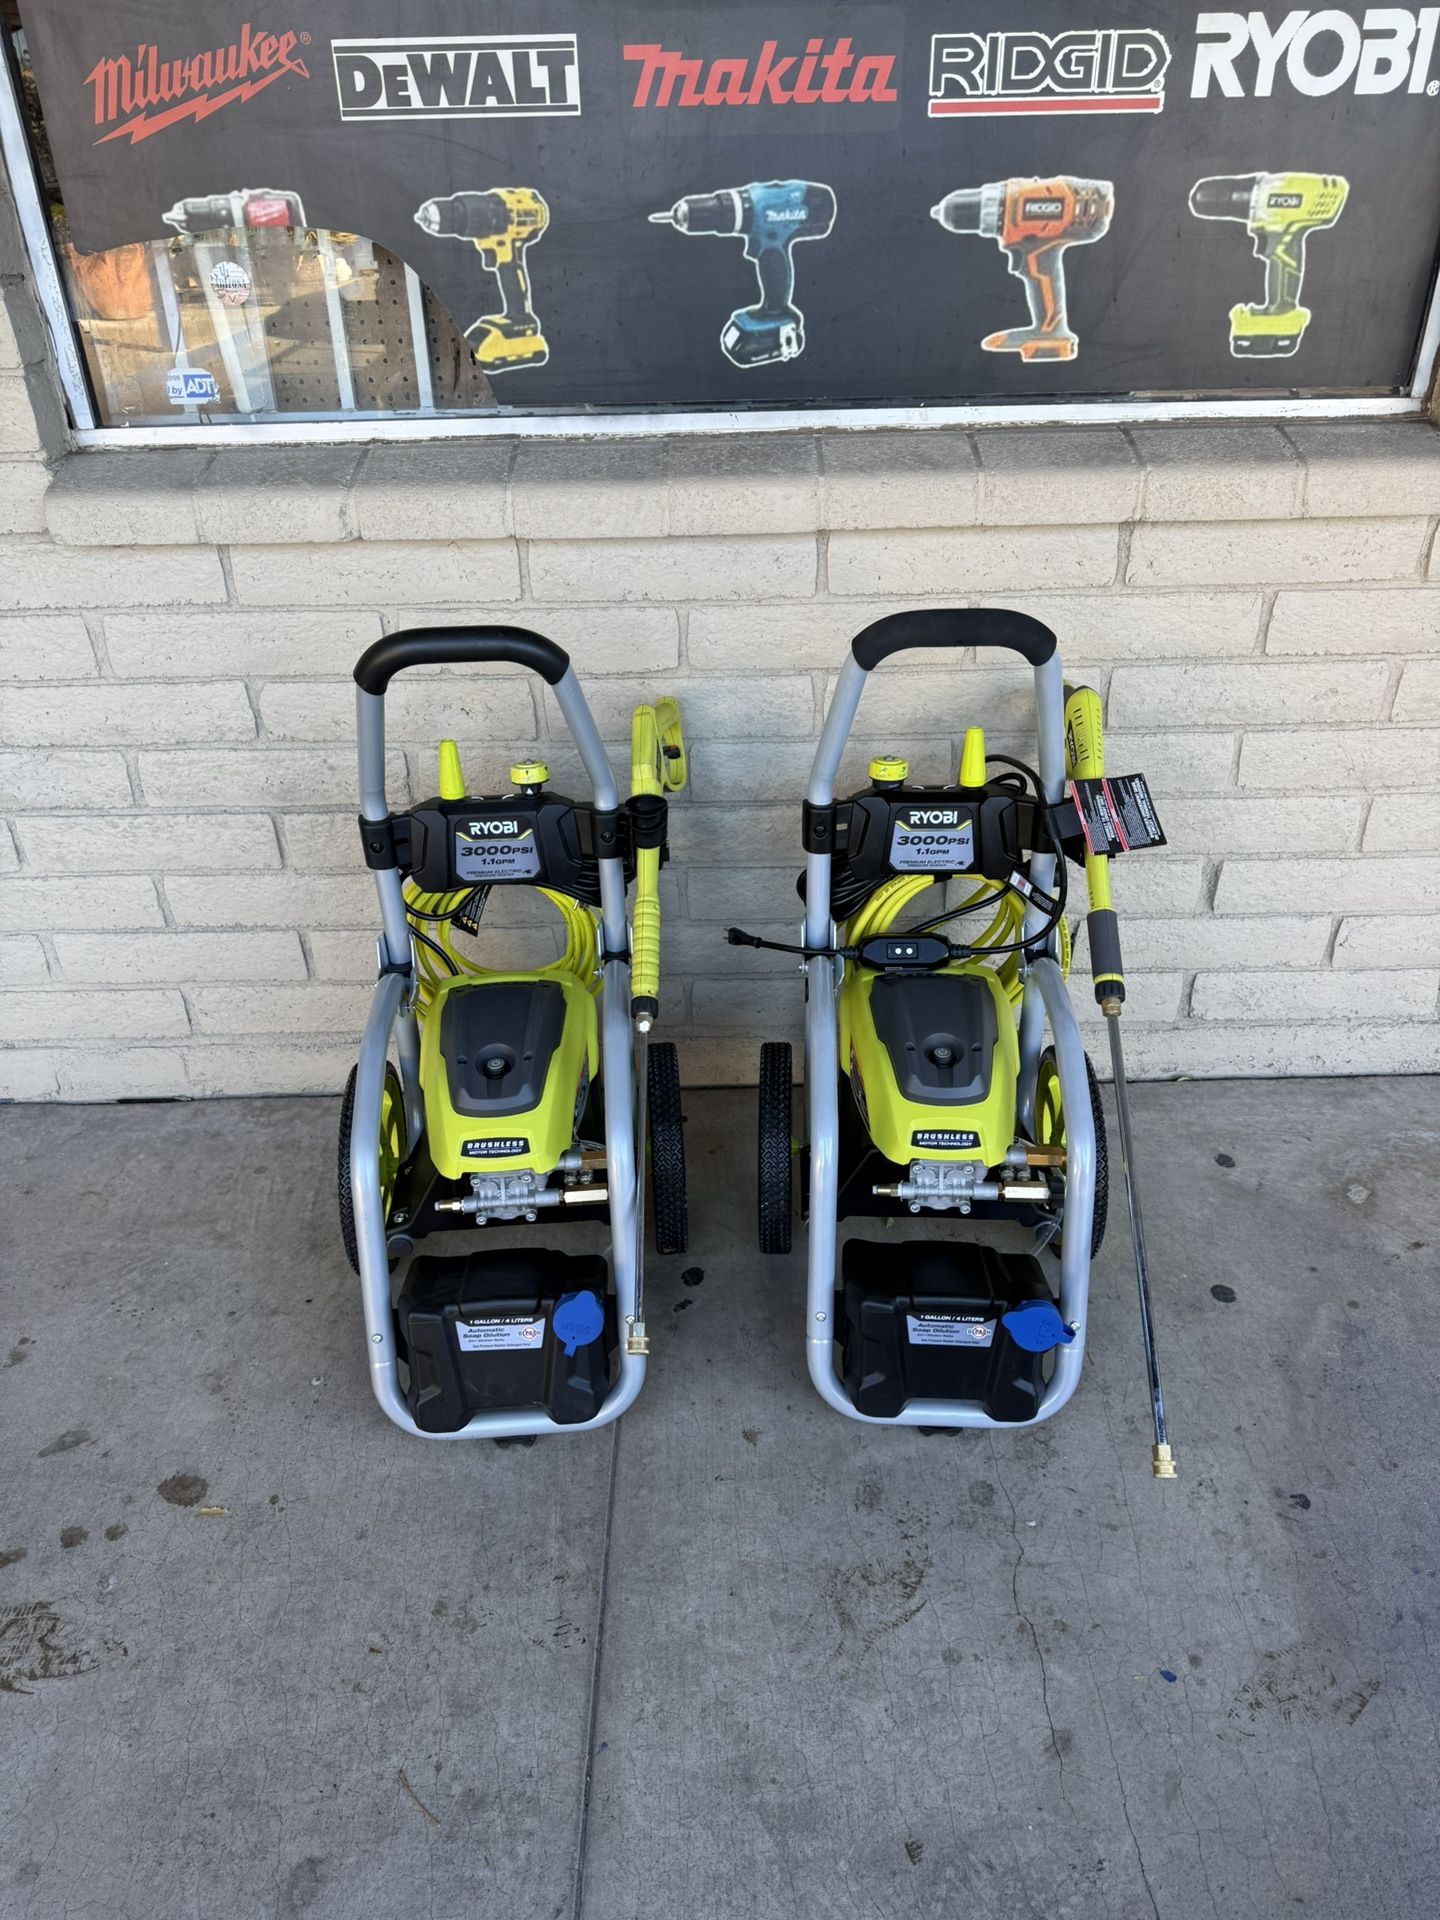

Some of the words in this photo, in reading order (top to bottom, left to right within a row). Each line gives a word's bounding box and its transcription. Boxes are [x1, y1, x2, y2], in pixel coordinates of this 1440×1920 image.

[1190, 8, 1440, 98] RYOBI
[929, 30, 1172, 96] RIDGID
[83, 23, 301, 125] Milwaukee
[172, 385, 183, 395] by
[186, 377, 212, 394] ADT
[909, 811, 958, 824] RYOBI
[469, 821, 518, 835] RYOBI
[897, 836, 970, 846] 3000PSI
[461, 845, 533, 857] 3000PSI
[467, 1140, 525, 1149] BRUSHLESS
